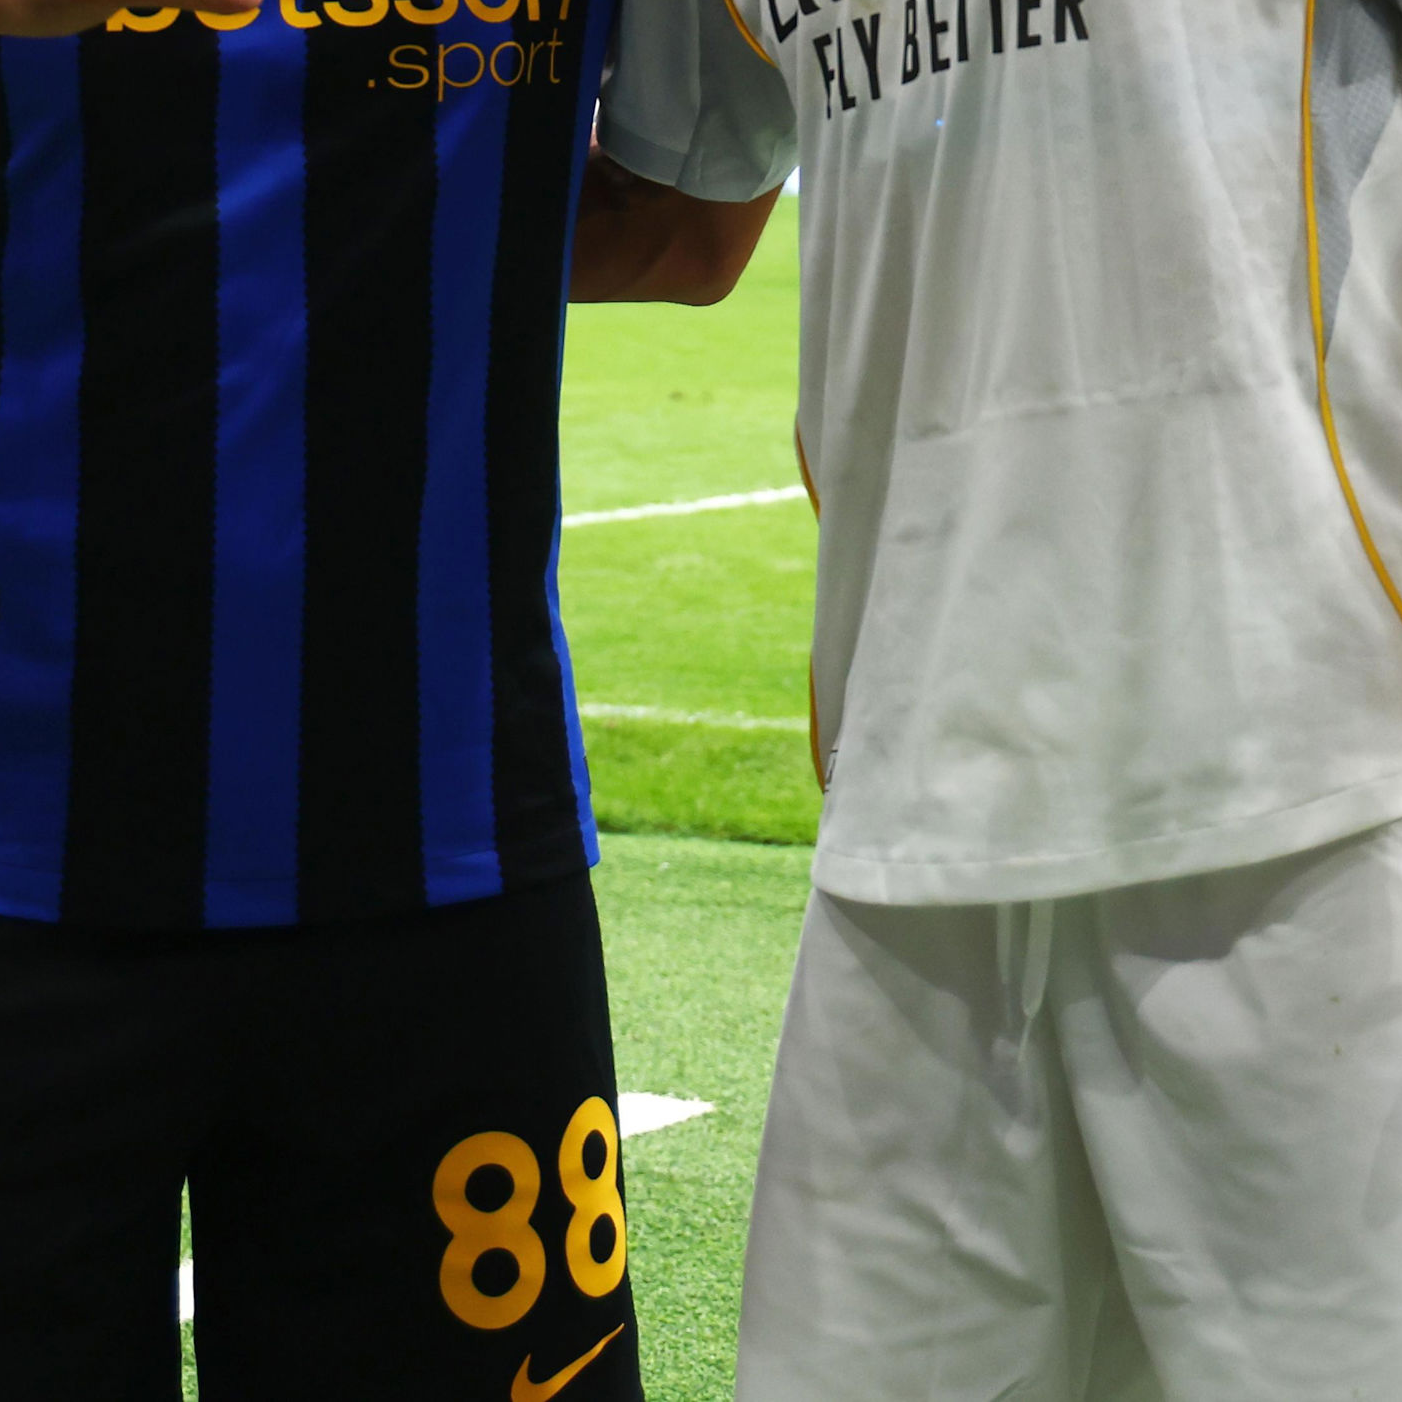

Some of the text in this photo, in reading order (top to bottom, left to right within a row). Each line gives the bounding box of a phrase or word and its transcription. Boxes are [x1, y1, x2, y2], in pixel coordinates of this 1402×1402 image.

[367, 29, 563, 102] .sport
[813, 13, 881, 119] FLY
[432, 1096, 626, 1330] 88
